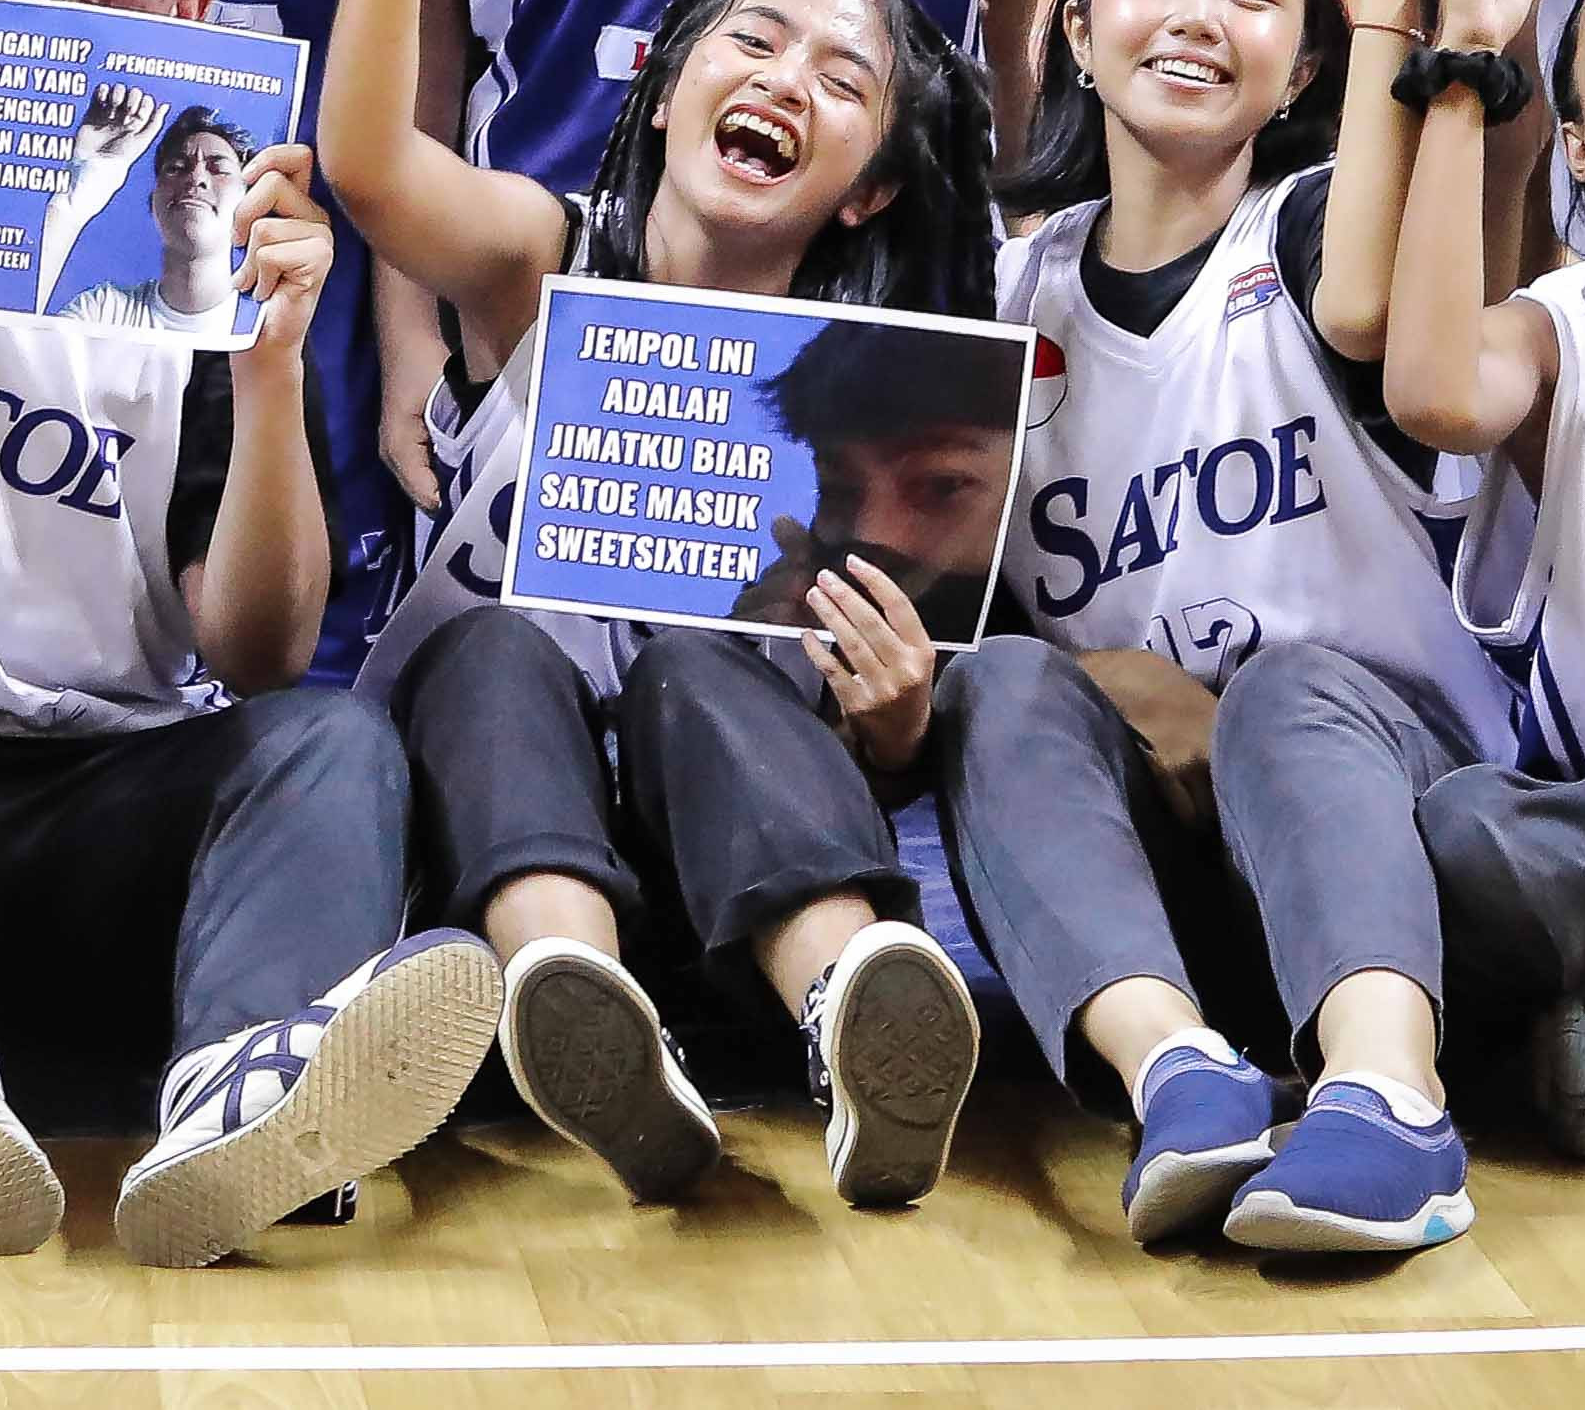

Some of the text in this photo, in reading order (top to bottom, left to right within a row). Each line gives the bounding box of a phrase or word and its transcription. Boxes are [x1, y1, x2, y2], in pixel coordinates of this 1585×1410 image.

[49, 35, 92, 64] INI?
[32, 66, 87, 96] YANG
[15, 131, 75, 162] AKAN
[579, 324, 757, 377] JEMPOL INI
[600, 377, 732, 426] ADALAH
[546, 423, 773, 481] JIMATKU BIAR
[538, 472, 763, 531] SATOE MASUK
[1029, 414, 1327, 620] SATOE
[536, 522, 761, 583] SWEETSIXTEEN
